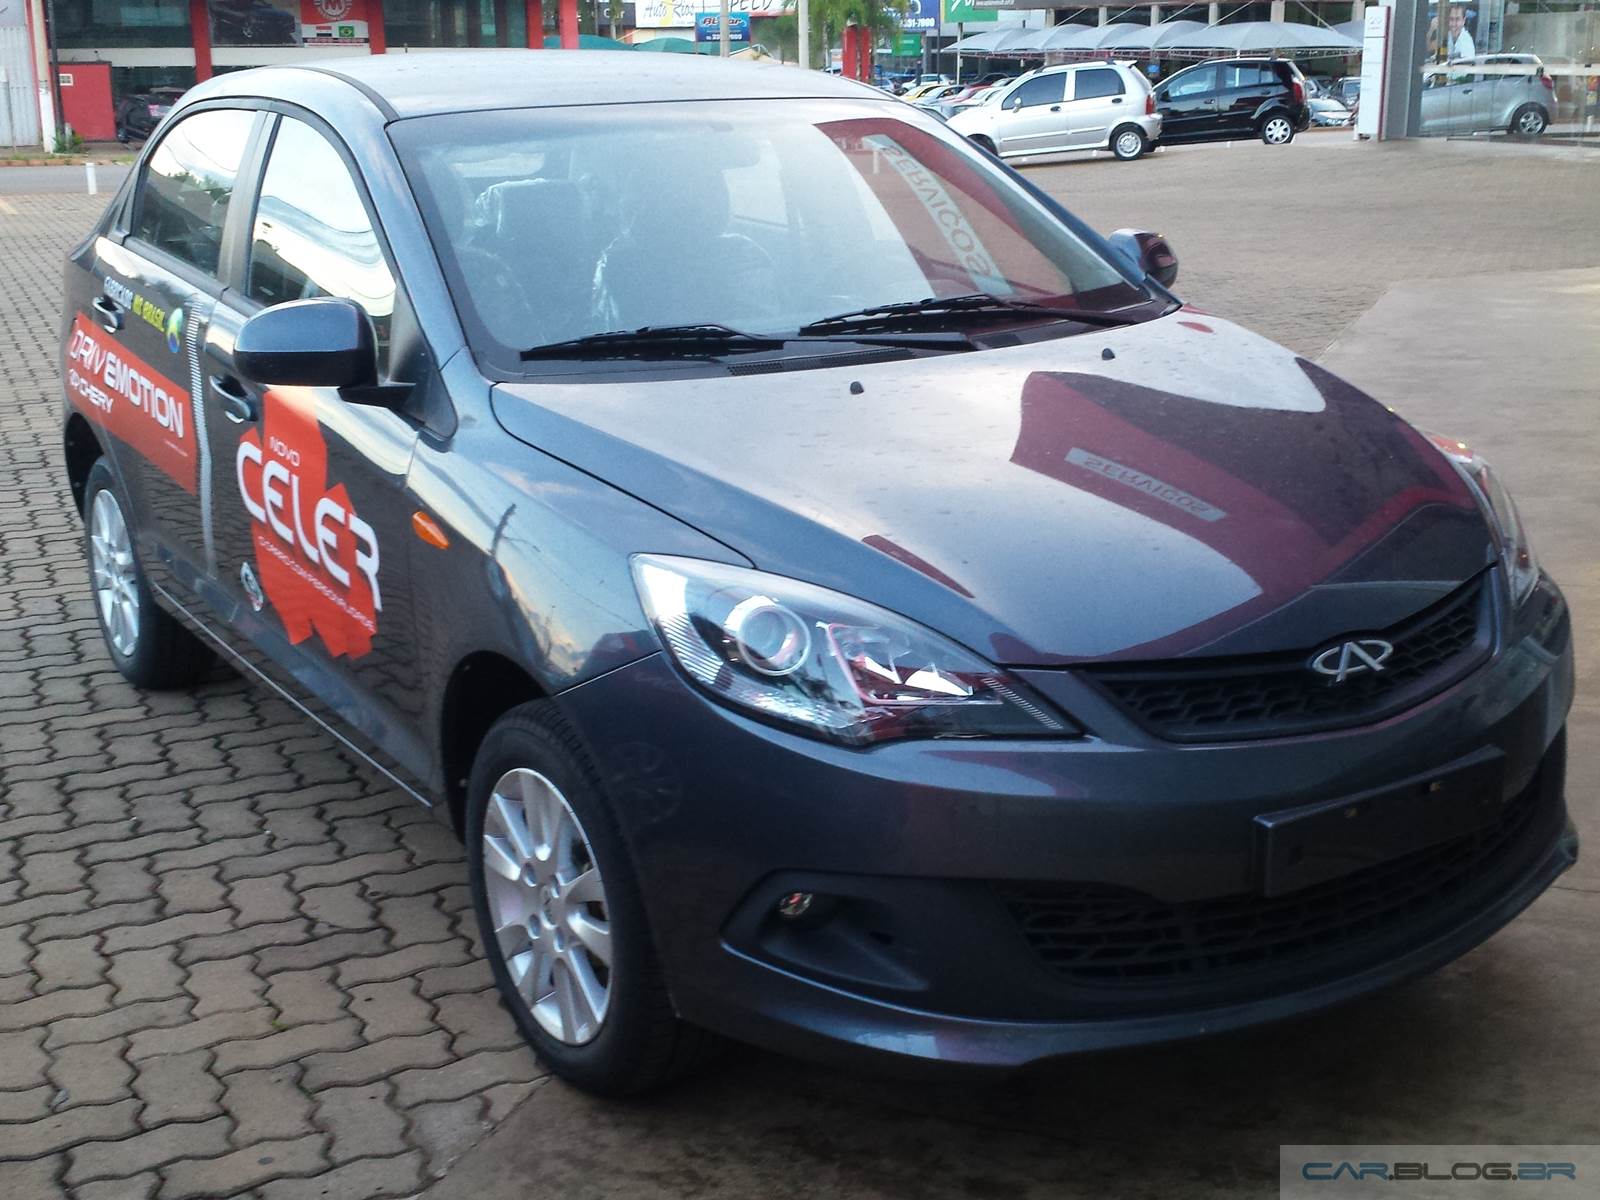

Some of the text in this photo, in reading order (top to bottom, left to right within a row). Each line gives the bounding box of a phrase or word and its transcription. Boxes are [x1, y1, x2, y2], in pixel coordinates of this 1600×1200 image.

[79, 378, 114, 414] CHERY
[269, 435, 300, 467] NOVO
[236, 440, 383, 612] CELER
